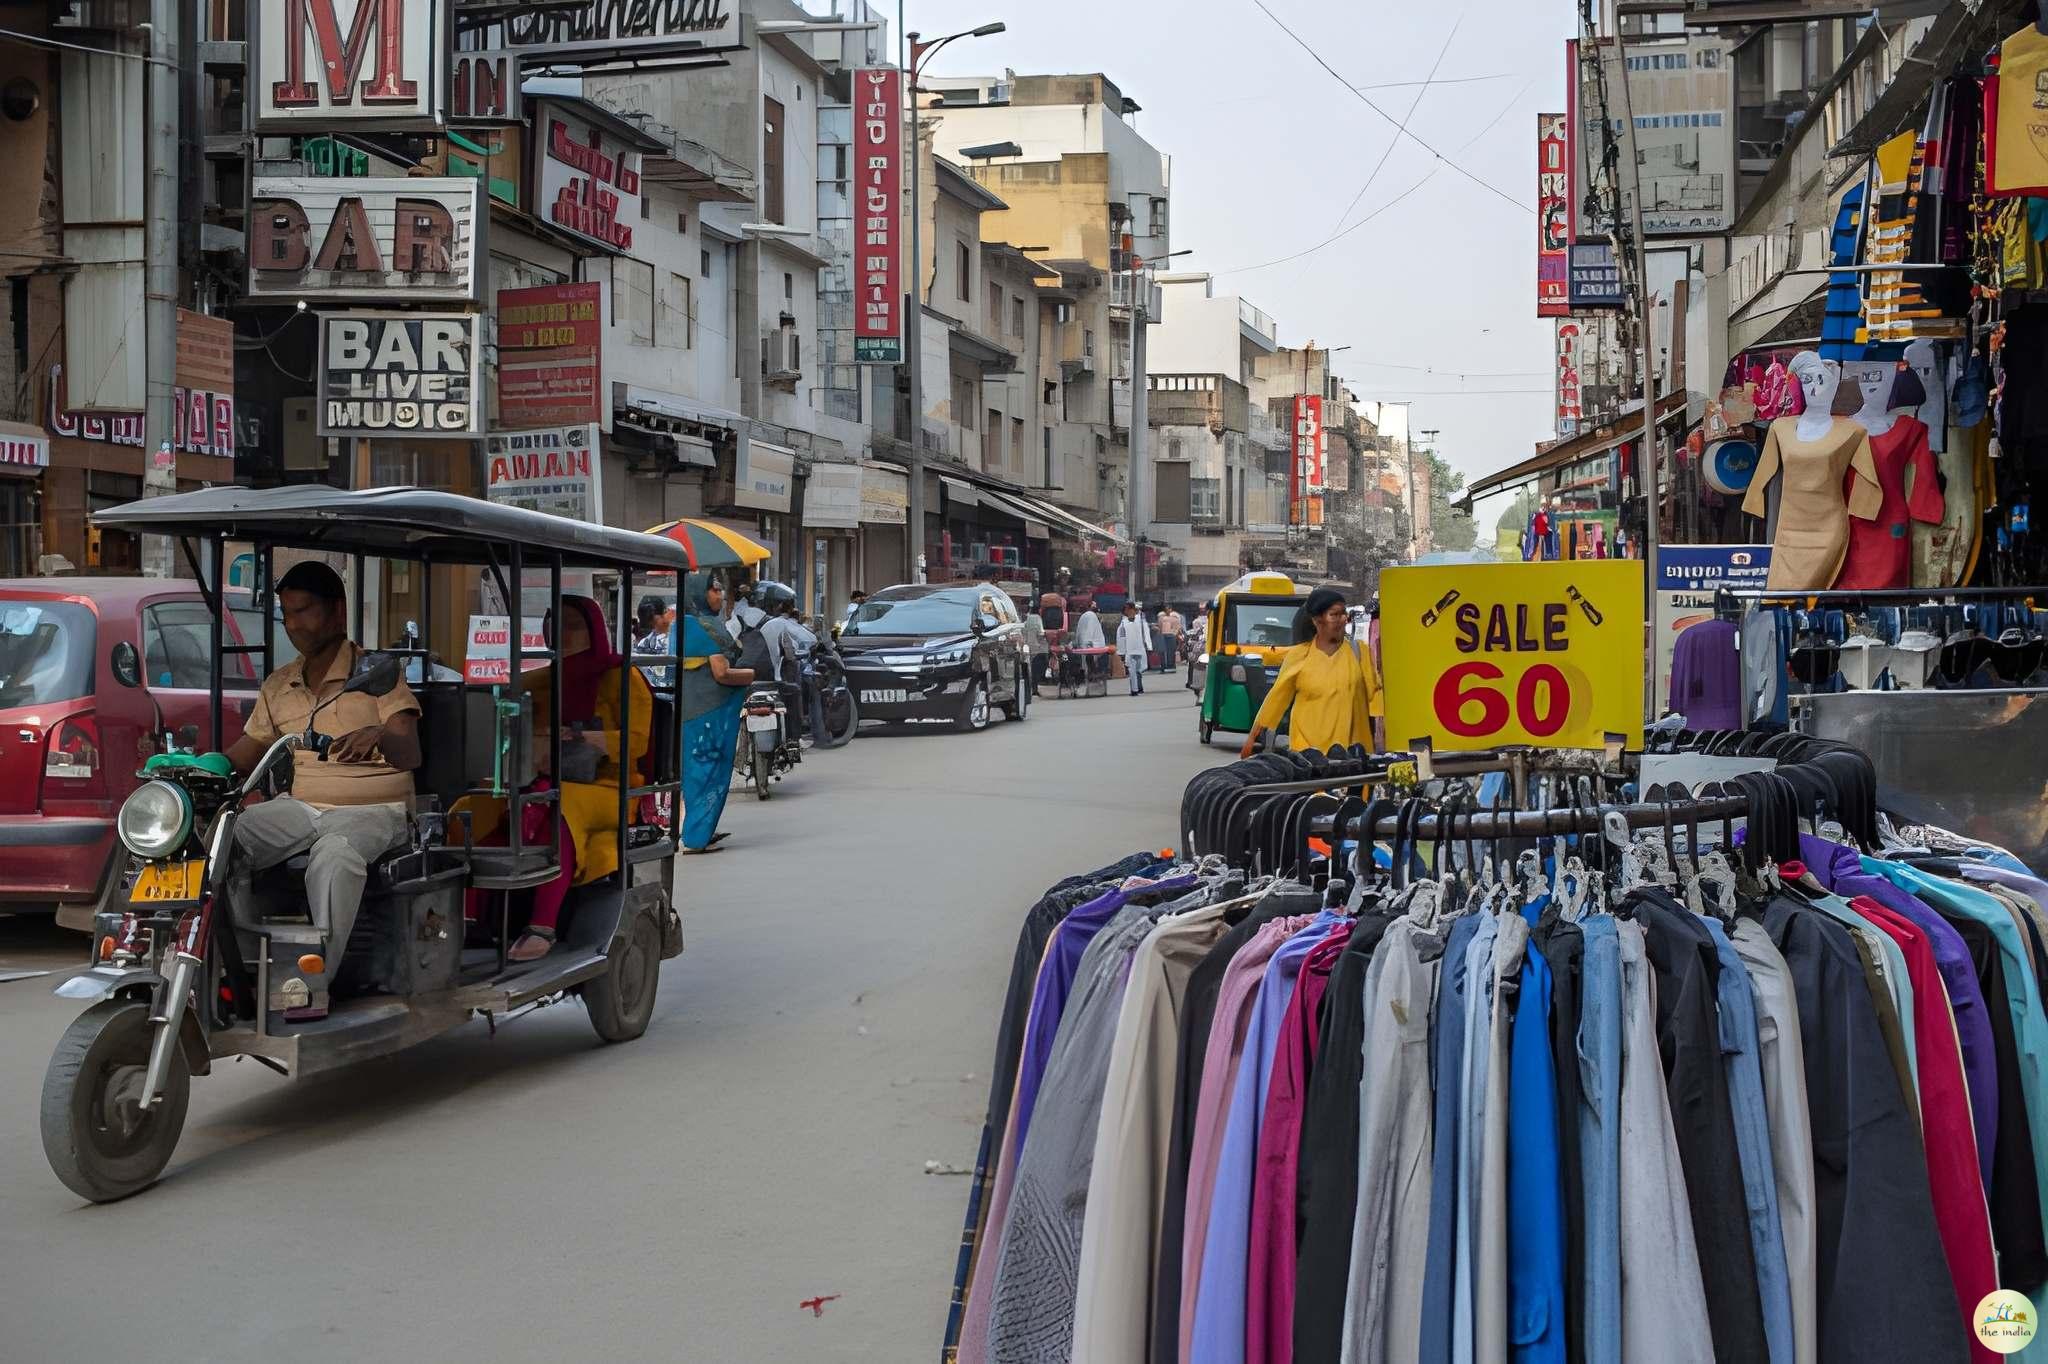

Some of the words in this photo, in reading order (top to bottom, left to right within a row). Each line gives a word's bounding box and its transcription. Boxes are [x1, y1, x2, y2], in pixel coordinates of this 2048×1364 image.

[252, 196, 454, 272] BAR
[328, 320, 466, 371] BAR
[351, 372, 447, 400] LIVE
[1455, 603, 1570, 653] SALE
[1433, 661, 1571, 738] 60
